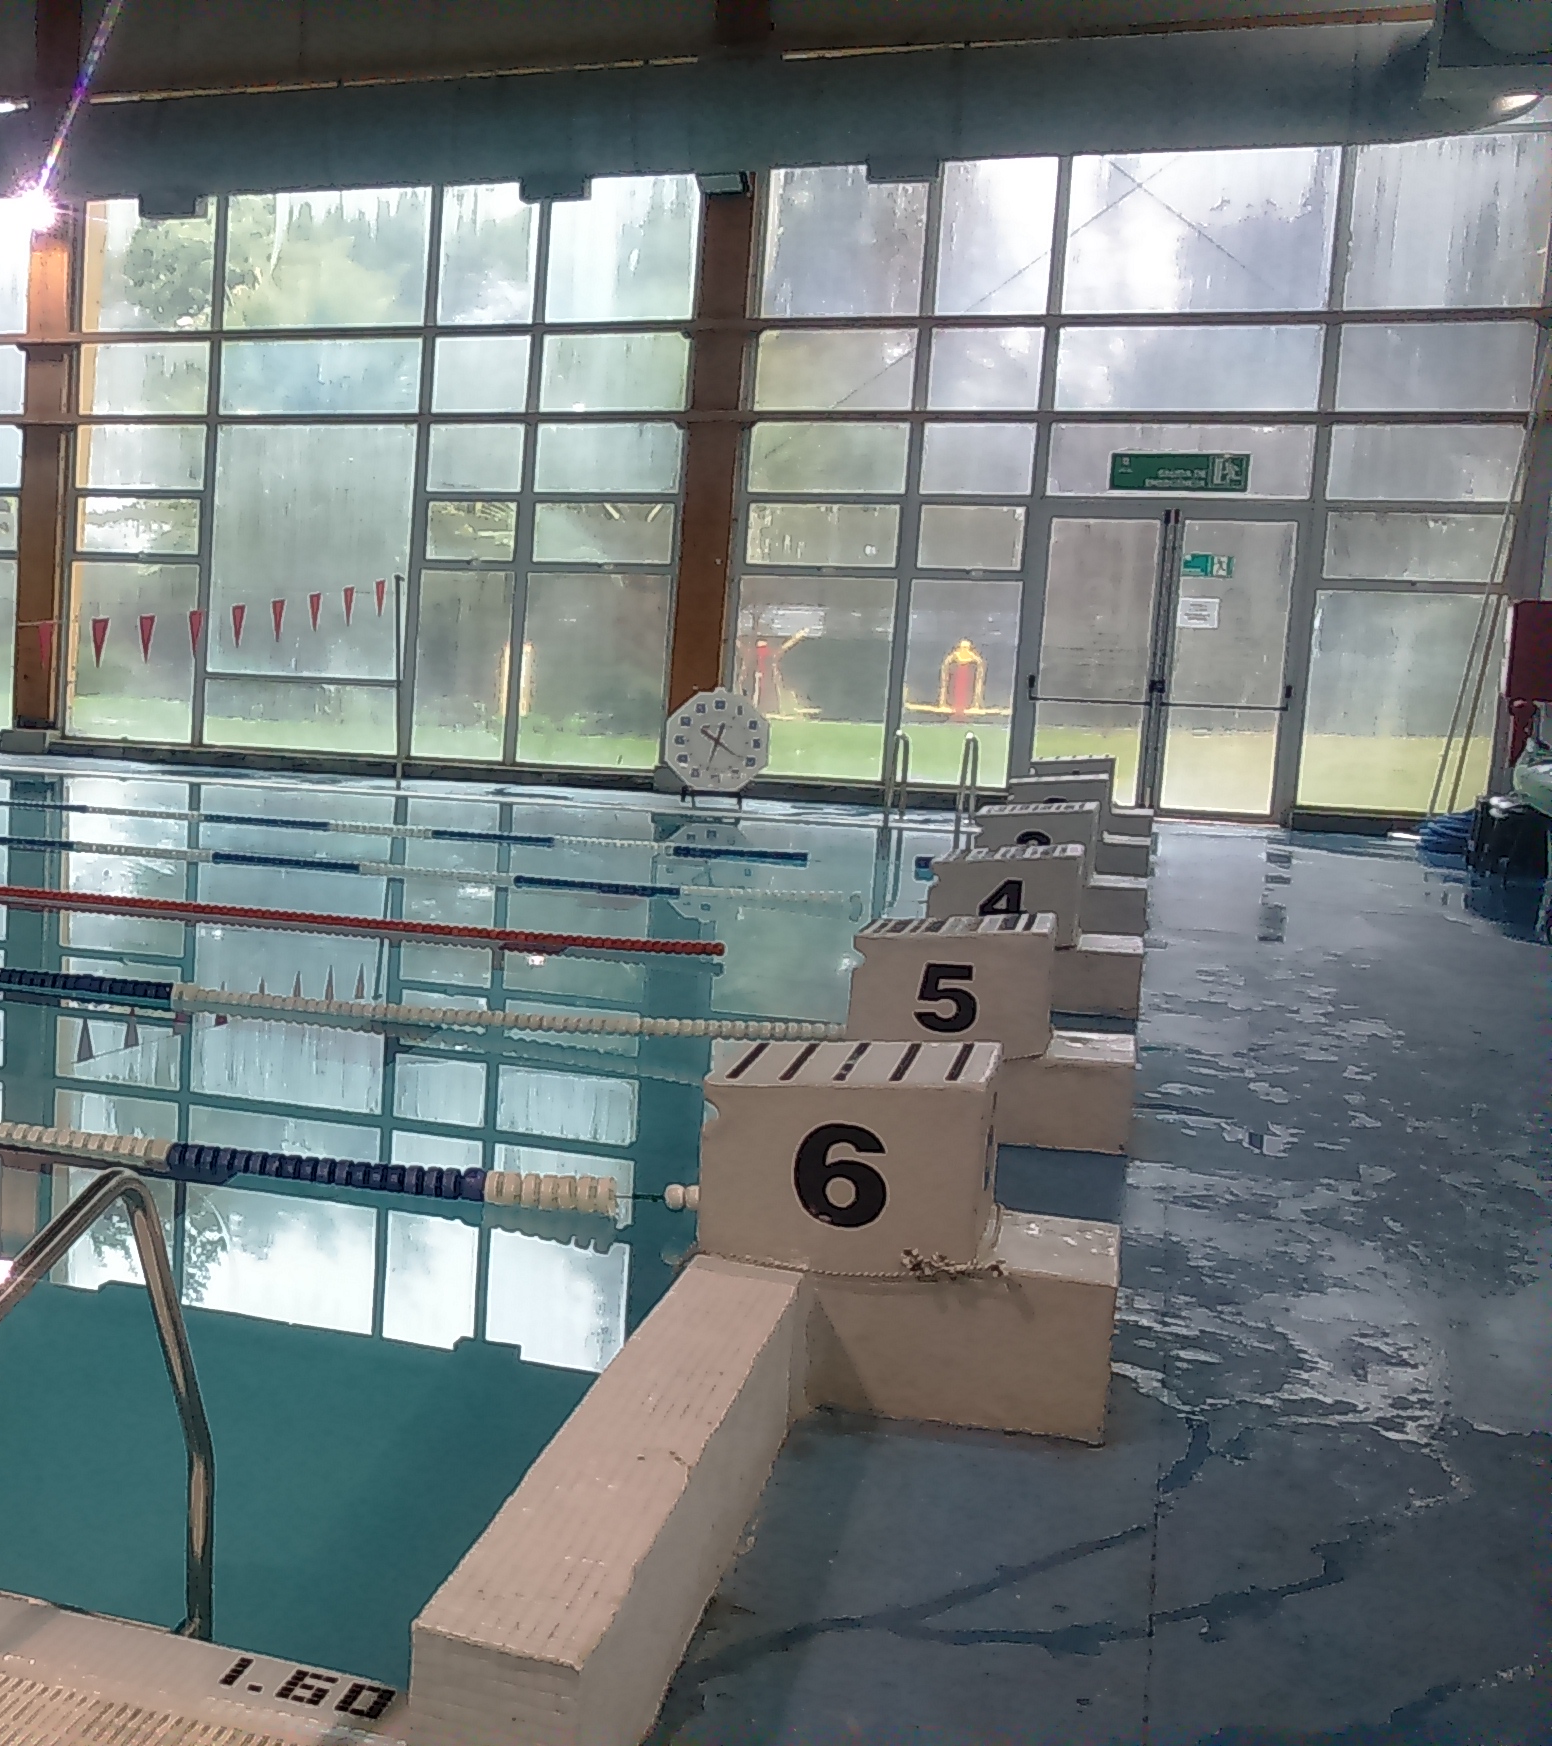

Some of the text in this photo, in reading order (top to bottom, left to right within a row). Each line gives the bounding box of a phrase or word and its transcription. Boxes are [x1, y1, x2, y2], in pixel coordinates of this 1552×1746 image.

[978, 879, 1027, 915] 4
[914, 963, 977, 1032] 5
[793, 1123, 887, 1227] 6
[218, 1657, 397, 1720] 1.60
